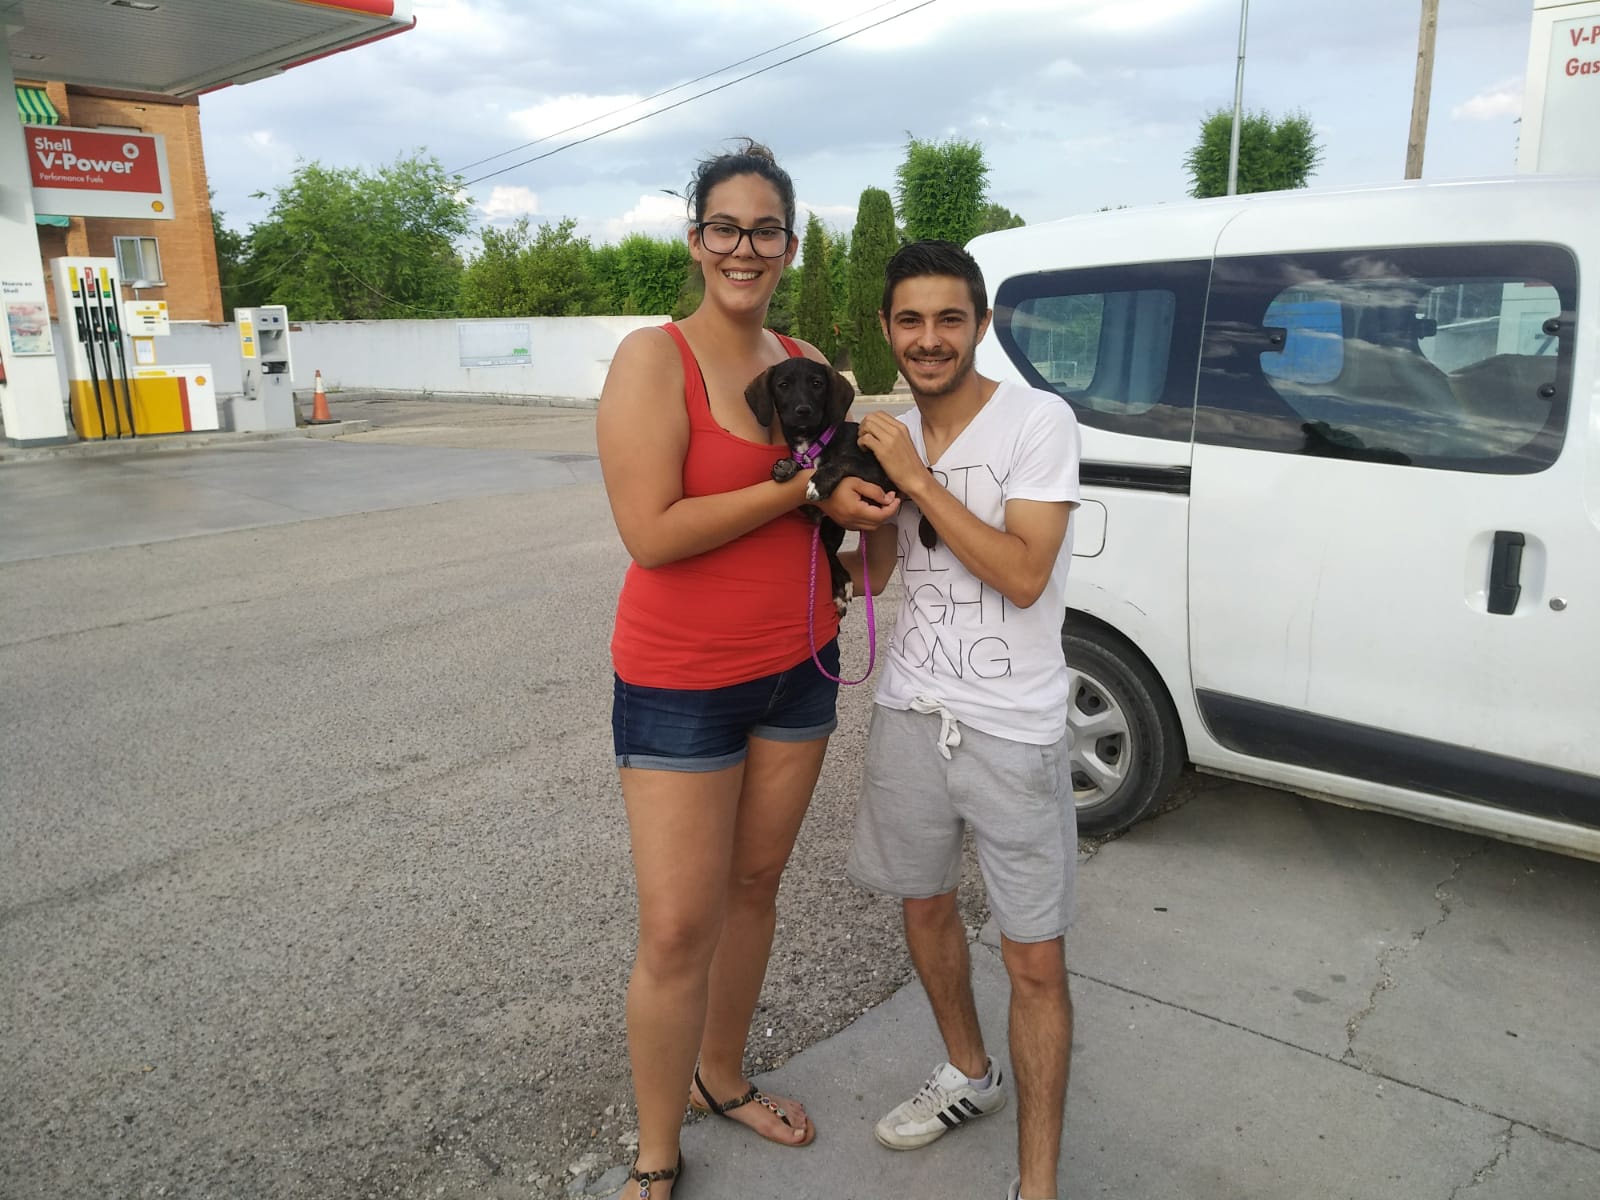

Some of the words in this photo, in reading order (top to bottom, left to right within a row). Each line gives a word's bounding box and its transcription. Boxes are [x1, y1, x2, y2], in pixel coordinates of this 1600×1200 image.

[34, 137, 72, 152] Shell
[36, 151, 134, 174] V-Power
[39, 172, 85, 184] Performance
[86, 175, 104, 184] Fuels
